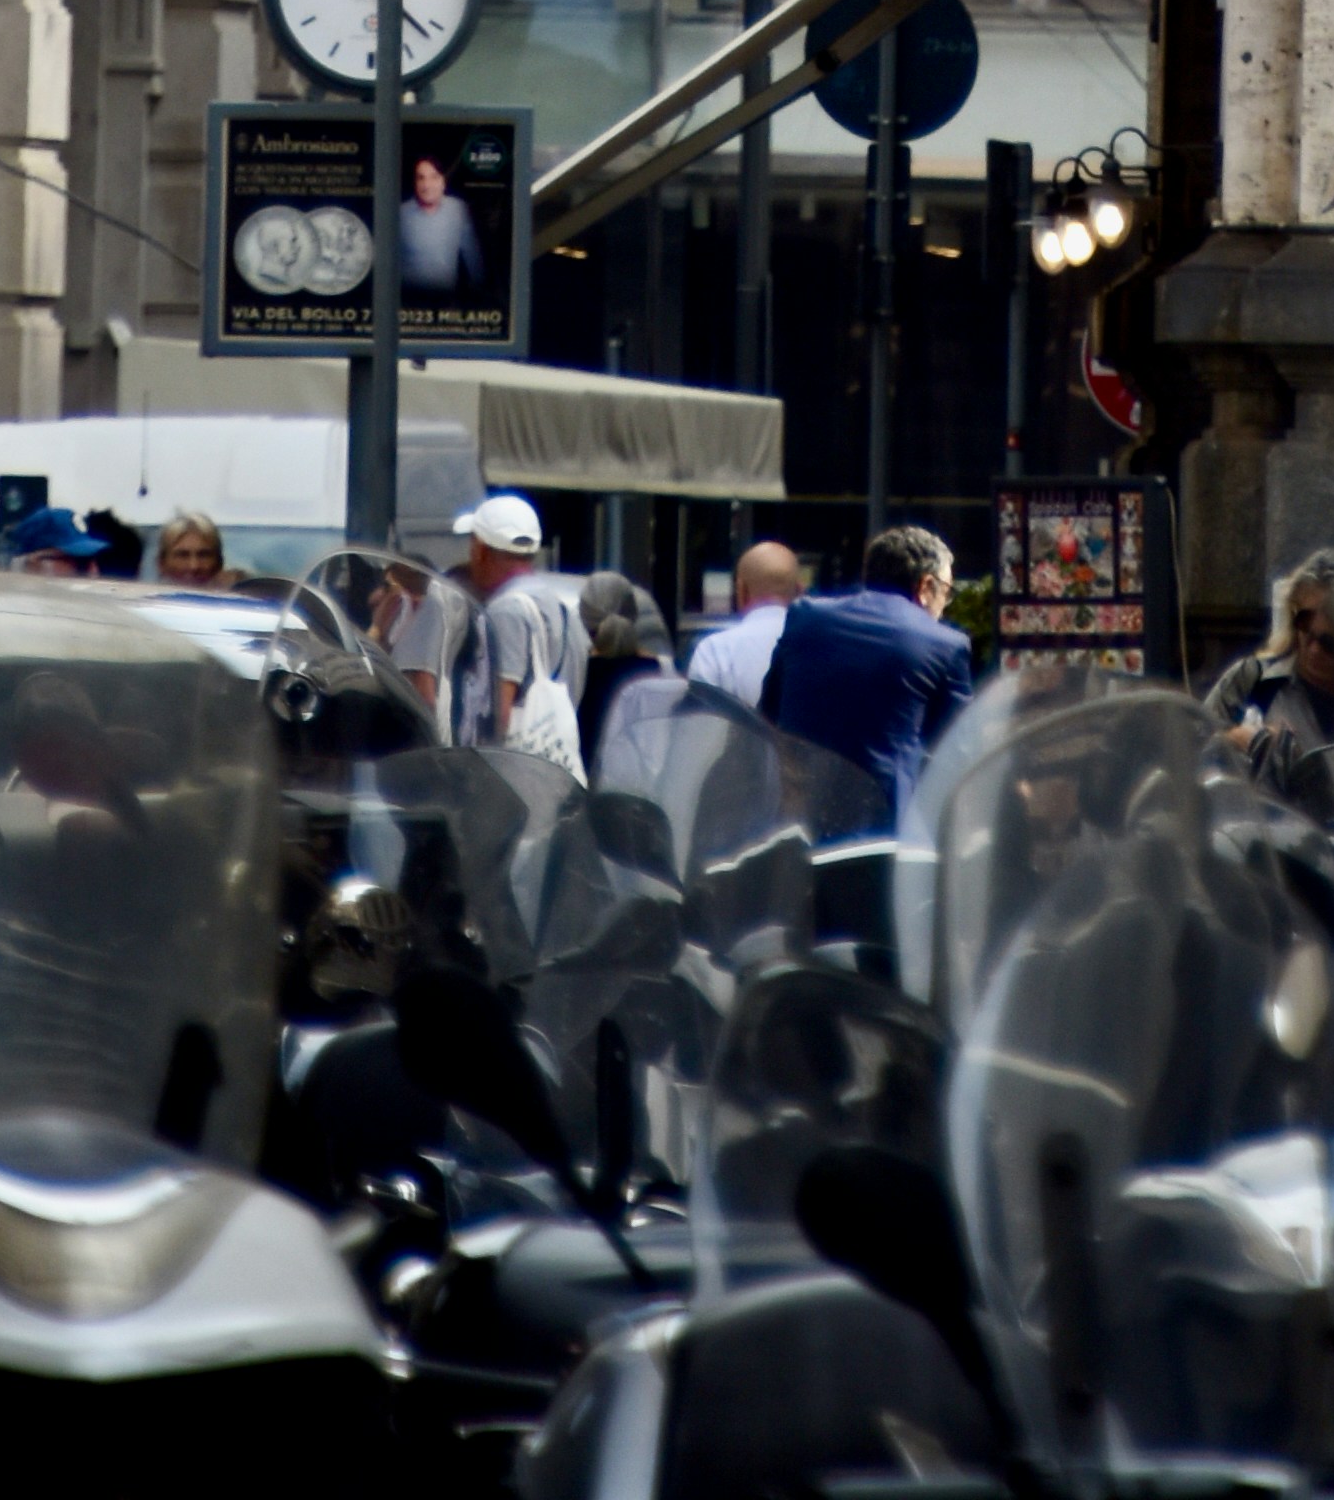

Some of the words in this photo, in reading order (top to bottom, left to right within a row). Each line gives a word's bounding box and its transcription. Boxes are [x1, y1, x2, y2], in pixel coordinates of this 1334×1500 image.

[252, 132, 359, 154] Ambrosiano
[232, 306, 260, 320] VIA
[264, 307, 296, 321] DEL
[299, 307, 357, 321] BOLLO
[360, 307, 371, 322] 7
[437, 310, 502, 324] MILANO
